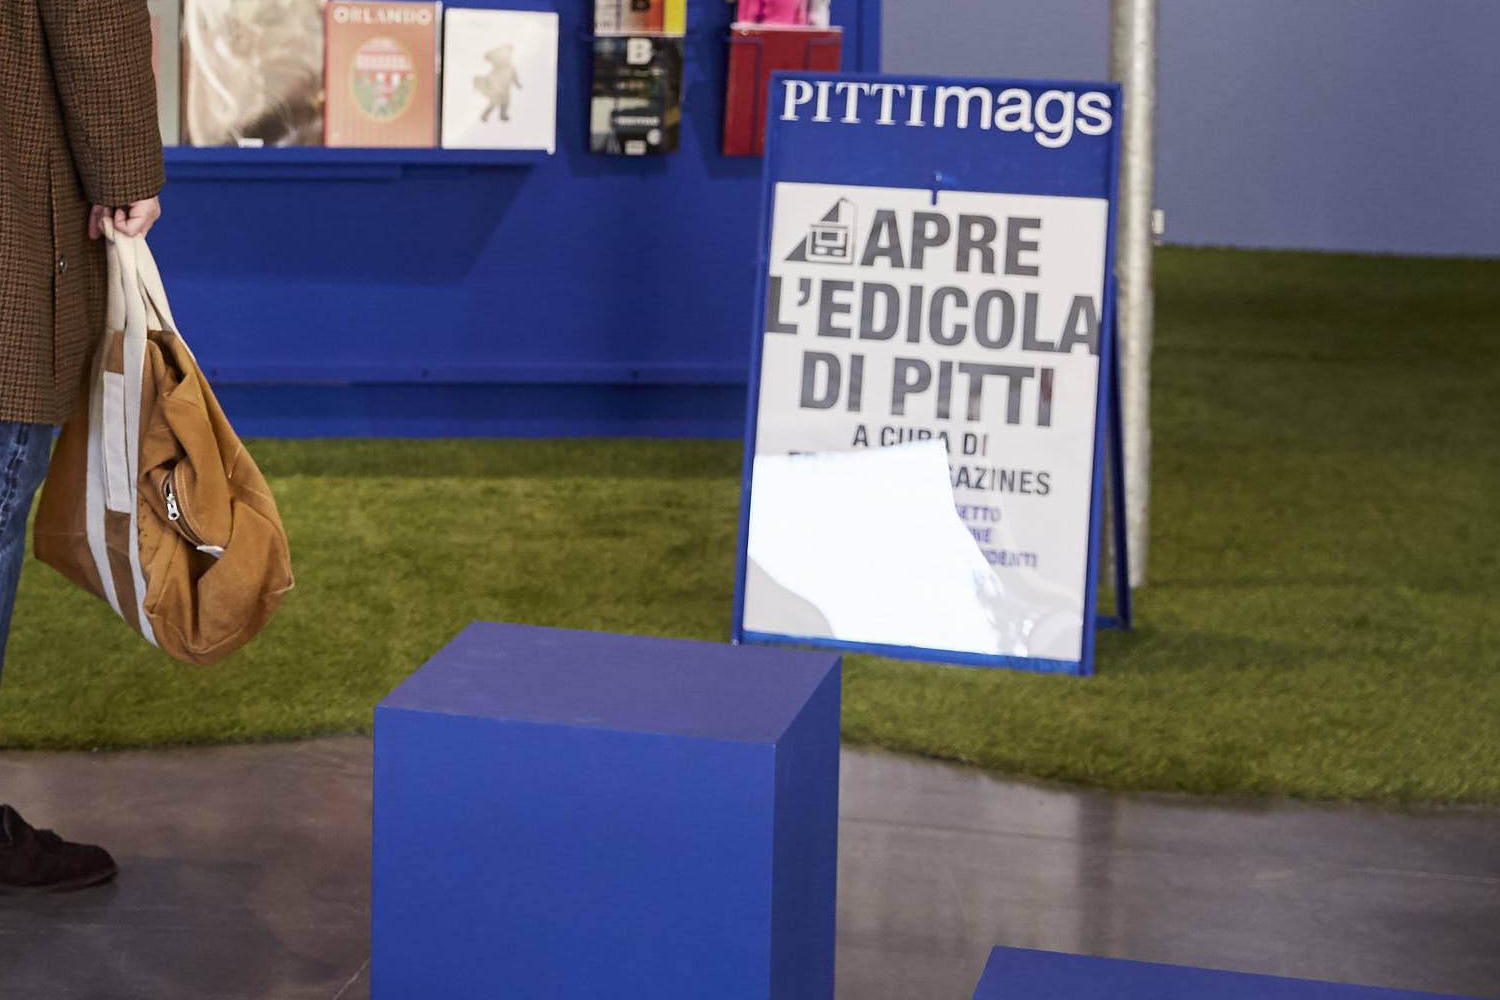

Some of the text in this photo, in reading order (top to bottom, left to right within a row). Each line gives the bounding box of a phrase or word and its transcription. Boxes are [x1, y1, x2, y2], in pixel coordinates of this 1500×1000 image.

[332, 6, 432, 26] ORLANDO
[627, 38, 653, 65] B
[860, 209, 1042, 277] APRE
[766, 275, 1101, 355] L'EDICOLA
[799, 350, 1055, 427] DI PITTI
[852, 424, 869, 447] A
[963, 433, 989, 457] DI
[949, 465, 1052, 496] AZINES
